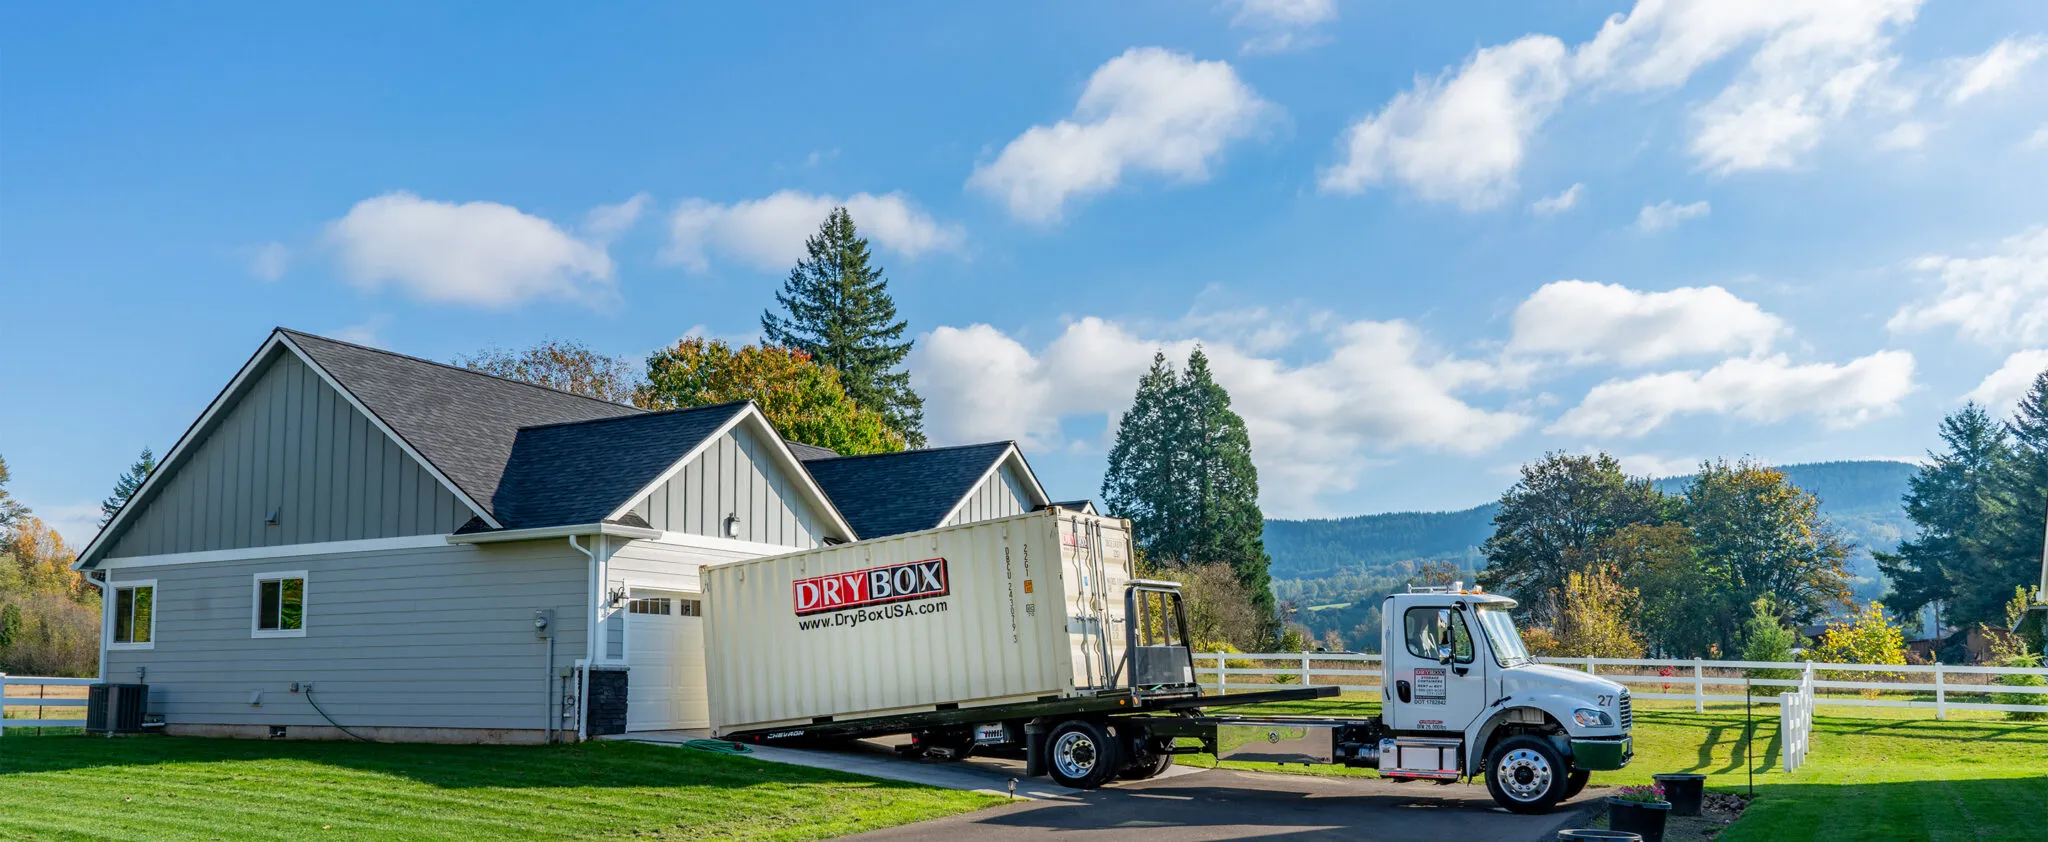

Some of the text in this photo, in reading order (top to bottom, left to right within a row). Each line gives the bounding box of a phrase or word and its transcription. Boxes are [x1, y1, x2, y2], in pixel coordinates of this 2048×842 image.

[796, 562, 942, 609] DRYBOX
[798, 601, 948, 631] www.DryBoxUSA.com
[1598, 695, 1613, 707] 27
[767, 730, 805, 739] CHEVRON
